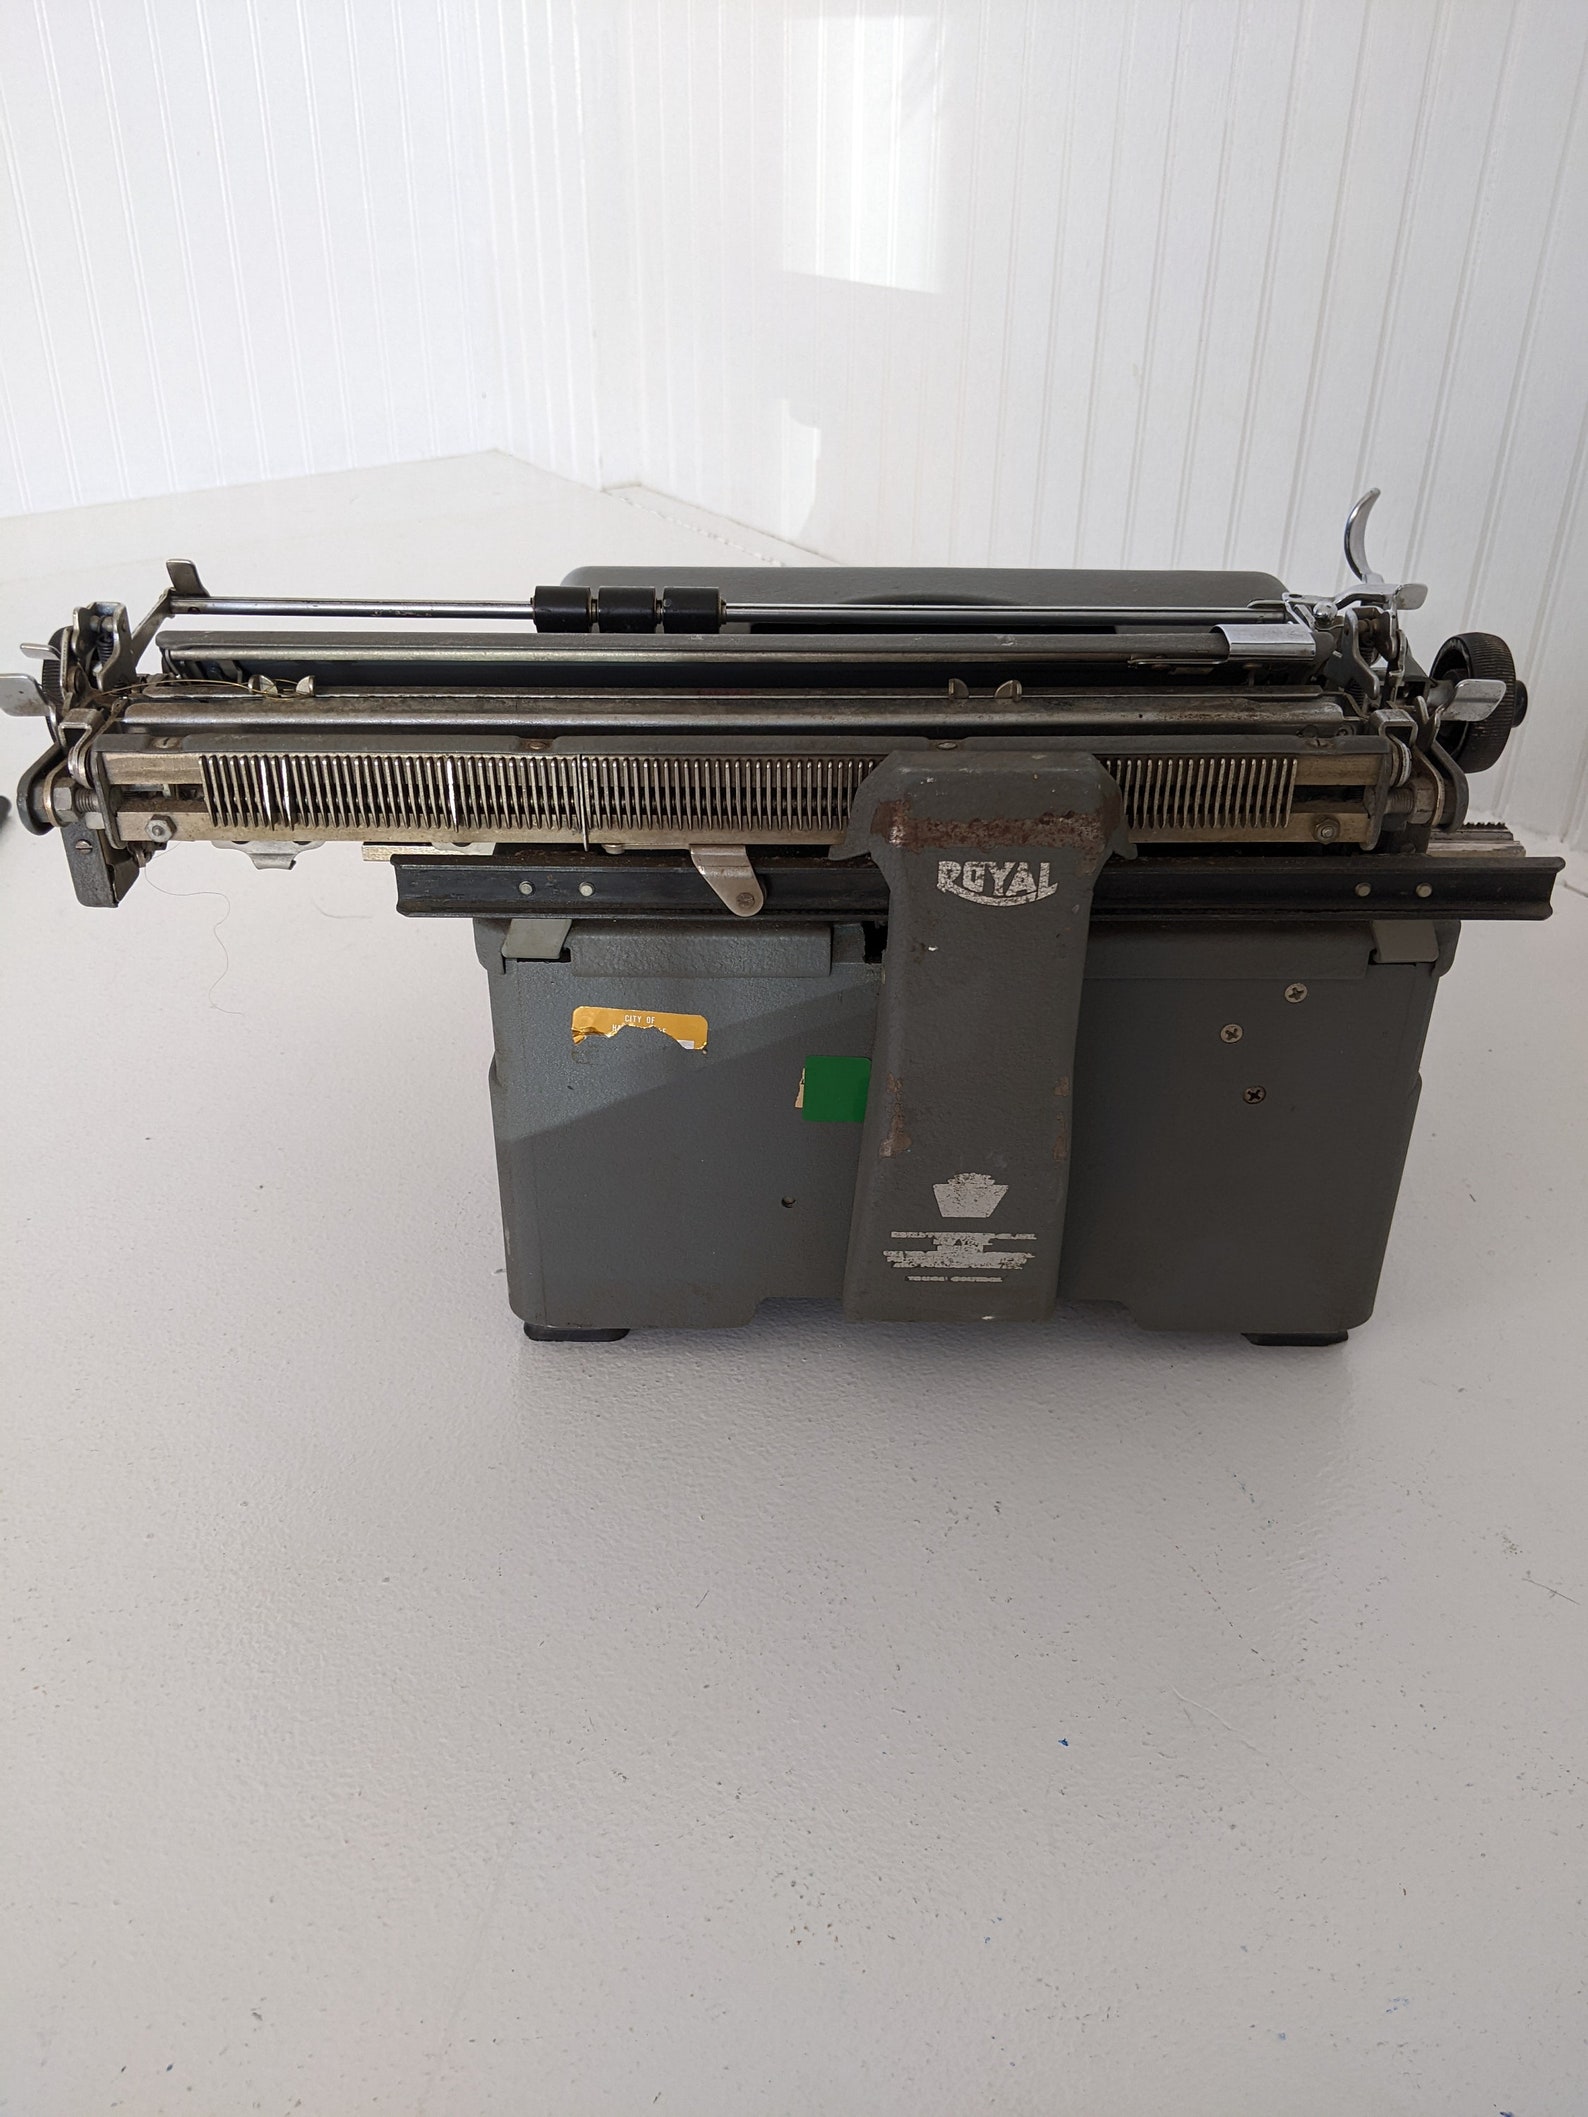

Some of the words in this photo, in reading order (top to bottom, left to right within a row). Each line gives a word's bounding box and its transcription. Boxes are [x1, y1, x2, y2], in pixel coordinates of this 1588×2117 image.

[937, 861, 1058, 906] ROYAL
[624, 1014, 642, 1023] CITY
[646, 1016, 656, 1024] OF
